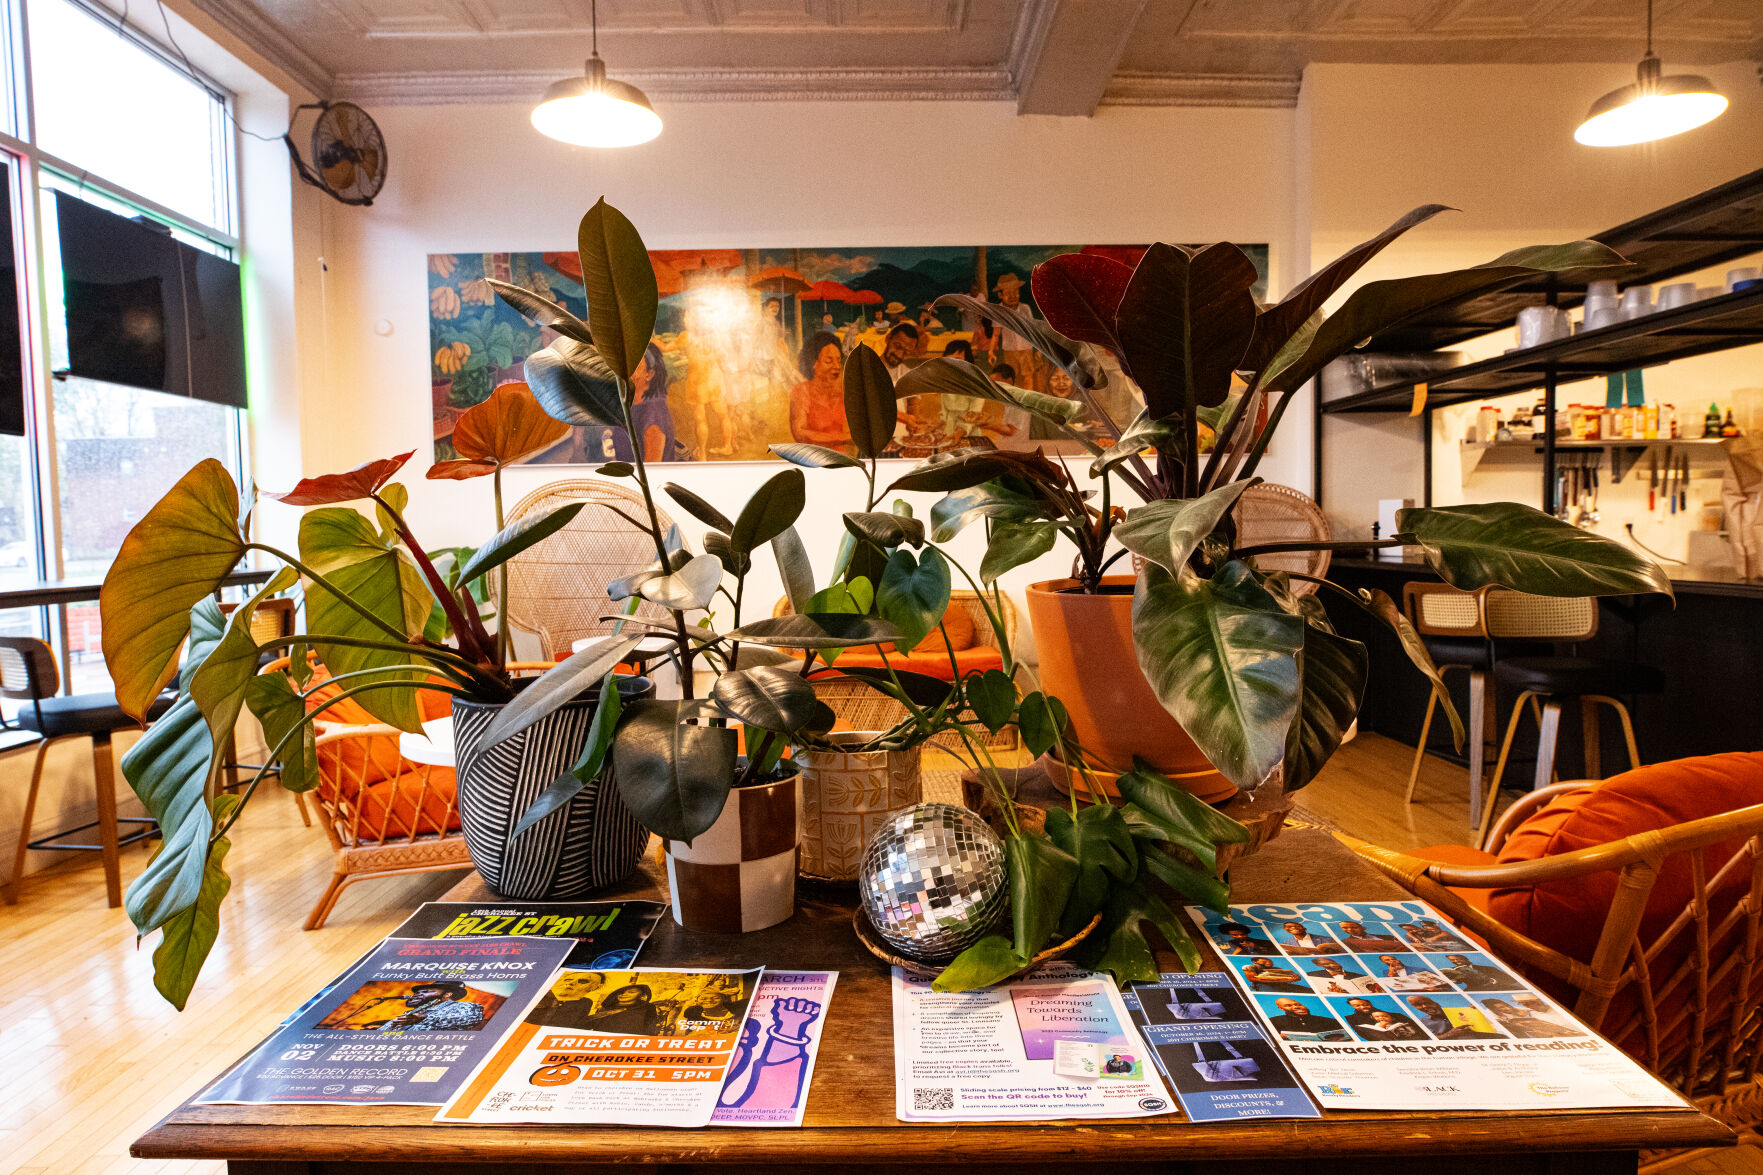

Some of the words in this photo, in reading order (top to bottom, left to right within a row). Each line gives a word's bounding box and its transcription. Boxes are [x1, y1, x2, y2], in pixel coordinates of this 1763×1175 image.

[432, 913, 517, 939] jazz
[509, 907, 622, 936] crawl
[380, 962, 478, 971] MARQUISE
[480, 961, 537, 970] KNOX
[372, 972, 412, 981] Funky
[446, 972, 483, 980] Brass
[1042, 1015, 1109, 1023] Liberation
[1194, 1023, 1250, 1031] OPENING
[326, 1033, 390, 1041] ALL-STYLES
[549, 1038, 617, 1049] TRICK
[619, 1039, 646, 1049] OR
[652, 1039, 727, 1049] TREAT
[1288, 1044, 1380, 1055] Embrace
[1381, 1044, 1419, 1054] the
[1420, 1043, 1486, 1055] power
[1488, 1042, 1512, 1052] of
[1513, 1039, 1604, 1052] reading!
[279, 1050, 317, 1061] 02
[658, 1056, 715, 1064] STREET
[262, 1067, 290, 1075] THE
[290, 1068, 349, 1076] GOLDEN
[350, 1068, 409, 1076] RECORD
[591, 1070, 631, 1079] OCT
[632, 1071, 656, 1079] 31
[671, 1070, 712, 1080] 5PM
[1064, 1093, 1088, 1101] buy!
[509, 1104, 555, 1112] cricket
[1214, 1100, 1275, 1109] DISCOUNTS,
[1237, 1109, 1273, 1117] MORE!
